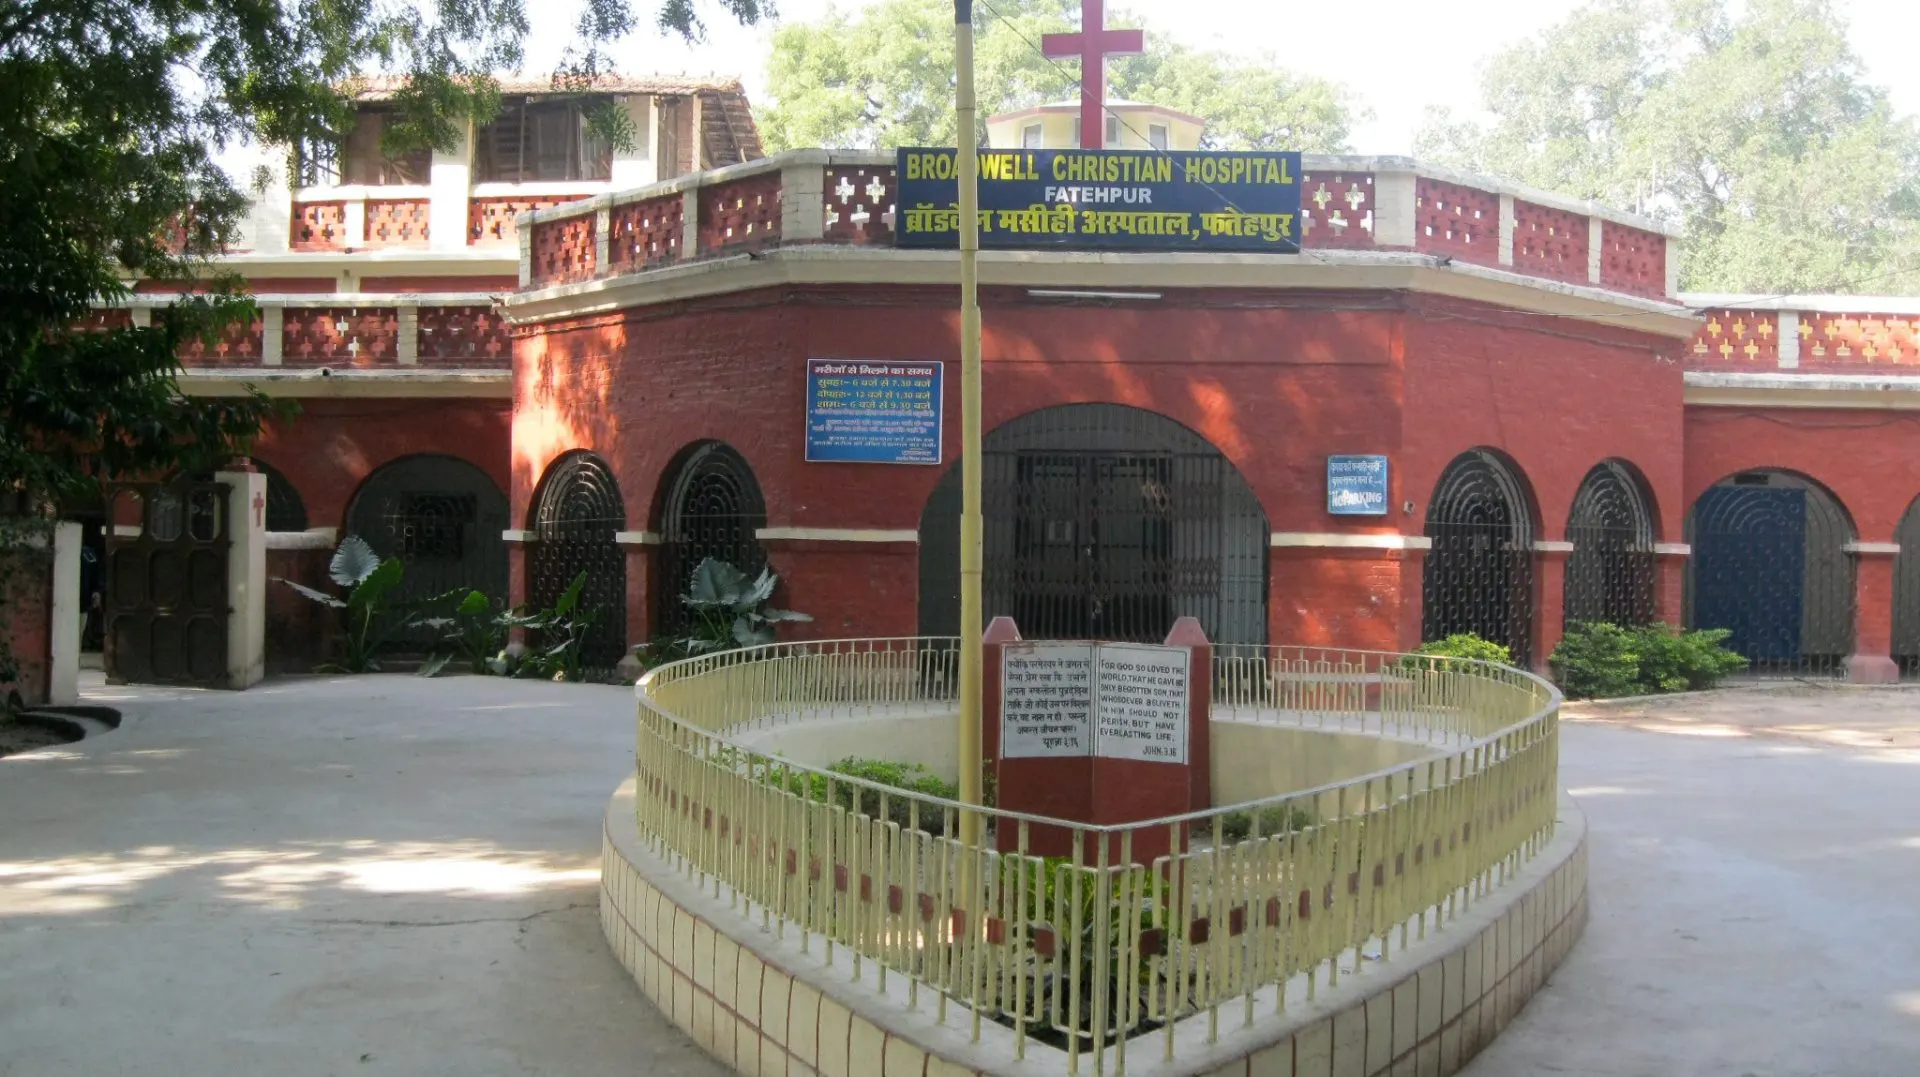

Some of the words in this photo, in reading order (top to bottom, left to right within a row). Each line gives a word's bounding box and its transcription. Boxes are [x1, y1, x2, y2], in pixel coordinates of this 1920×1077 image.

[907, 153, 1039, 181] BROAWELL
[1052, 155, 1172, 183] CHRISTIAN
[1185, 157, 1293, 184] HOSPITAL
[1044, 186, 1152, 203] FATEHPUR
[997, 203, 1078, 233] मसीही
[1081, 211, 1199, 240] अस्पताल,
[1200, 206, 1293, 241] फतेहपुर
[848, 366, 857, 375] से
[890, 367, 905, 375] का
[1101, 660, 1115, 670] FOR
[1117, 662, 1134, 672] GOD
[1136, 664, 1146, 673] SO
[1147, 665, 1170, 674] LOVED
[1172, 666, 1185, 675] THE
[1147, 676, 1156, 685] HE
[1157, 677, 1174, 686] GAVE
[1101, 683, 1116, 692] ONLY
[1117, 684, 1152, 696] BEGOTTEN
[1101, 695, 1143, 705] WHOSOEVER
[1101, 705, 1108, 713] IN
[1110, 707, 1125, 715] HIM
[1129, 708, 1158, 718] SHOULD
[1163, 711, 1180, 720] NOT
[1132, 719, 1150, 728] BUT
[1155, 721, 1177, 730] HAVE
[1100, 727, 1152, 740] EVERLASTING
